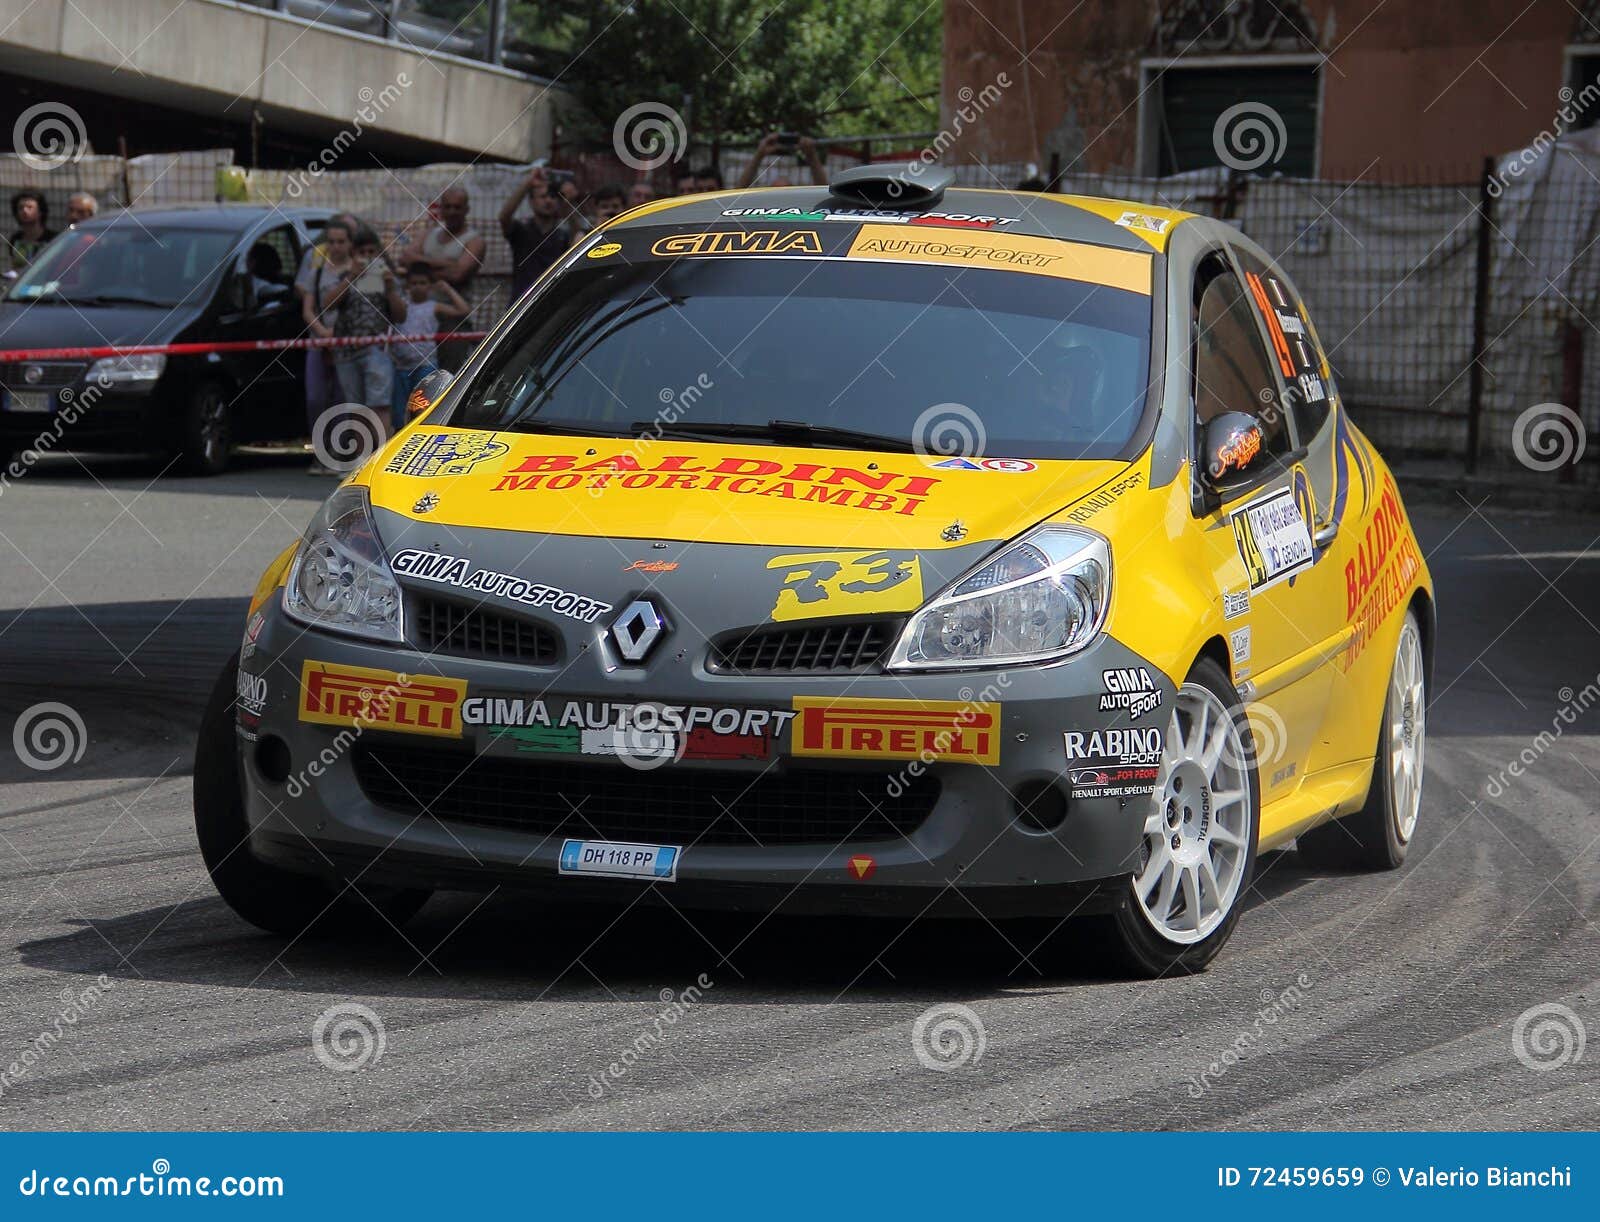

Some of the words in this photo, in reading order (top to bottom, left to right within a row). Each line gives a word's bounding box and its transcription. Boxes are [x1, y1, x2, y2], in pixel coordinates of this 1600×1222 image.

[721, 208, 801, 217] GIMA
[810, 208, 1019, 225] AUTOSPORT
[652, 231, 823, 256] GIMA
[858, 239, 1062, 268] AUTOSPORT
[385, 434, 427, 473] CONCORRENTE
[507, 455, 942, 496] BALDINI
[490, 474, 926, 516] MOTORICAMBI
[1067, 490, 1117, 523] RENAULT
[1111, 472, 1145, 496] SPORT
[1281, 538, 1308, 564] GENOVA
[390, 549, 469, 585] GIMA
[464, 571, 612, 623] AUTOSPORT
[1102, 667, 1154, 692] GIMA
[306, 671, 458, 730] PIRELLI
[462, 697, 550, 727] GIMA
[558, 700, 796, 738] AUTOSPORT
[1099, 694, 1130, 712] AUTO
[1130, 690, 1162, 720] SPORT
[803, 707, 993, 755] PIRELLI
[1064, 728, 1161, 759] RABINO
[1120, 752, 1161, 764] SPORT
[1072, 788, 1102, 798] RENAULT
[1104, 787, 1123, 797] SPORT
[1125, 785, 1157, 795] SPÉCIALIST
[1198, 785, 1209, 842] FONDMETAL
[584, 849, 605, 863] DH
[609, 850, 631, 866] 118
[633, 852, 653, 867] PP
